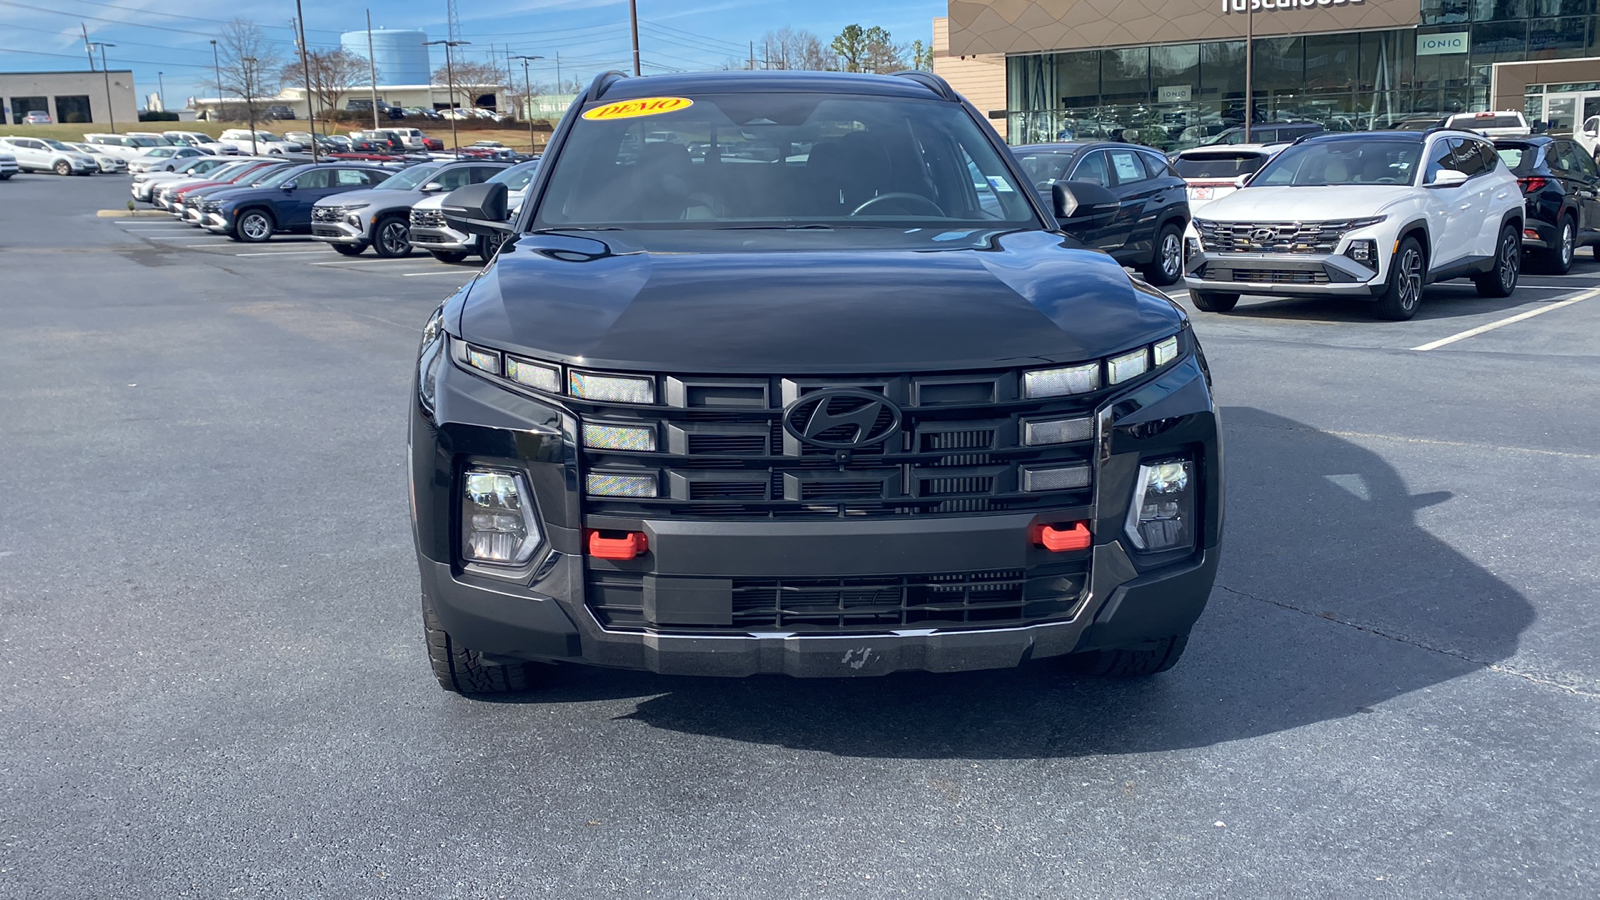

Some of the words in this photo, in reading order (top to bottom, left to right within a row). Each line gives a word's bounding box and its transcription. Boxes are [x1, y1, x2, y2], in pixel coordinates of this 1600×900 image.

[1222, 0, 1362, 12] Tusca
[1422, 38, 1461, 49] IONIQ
[597, 99, 681, 117] DEMO
